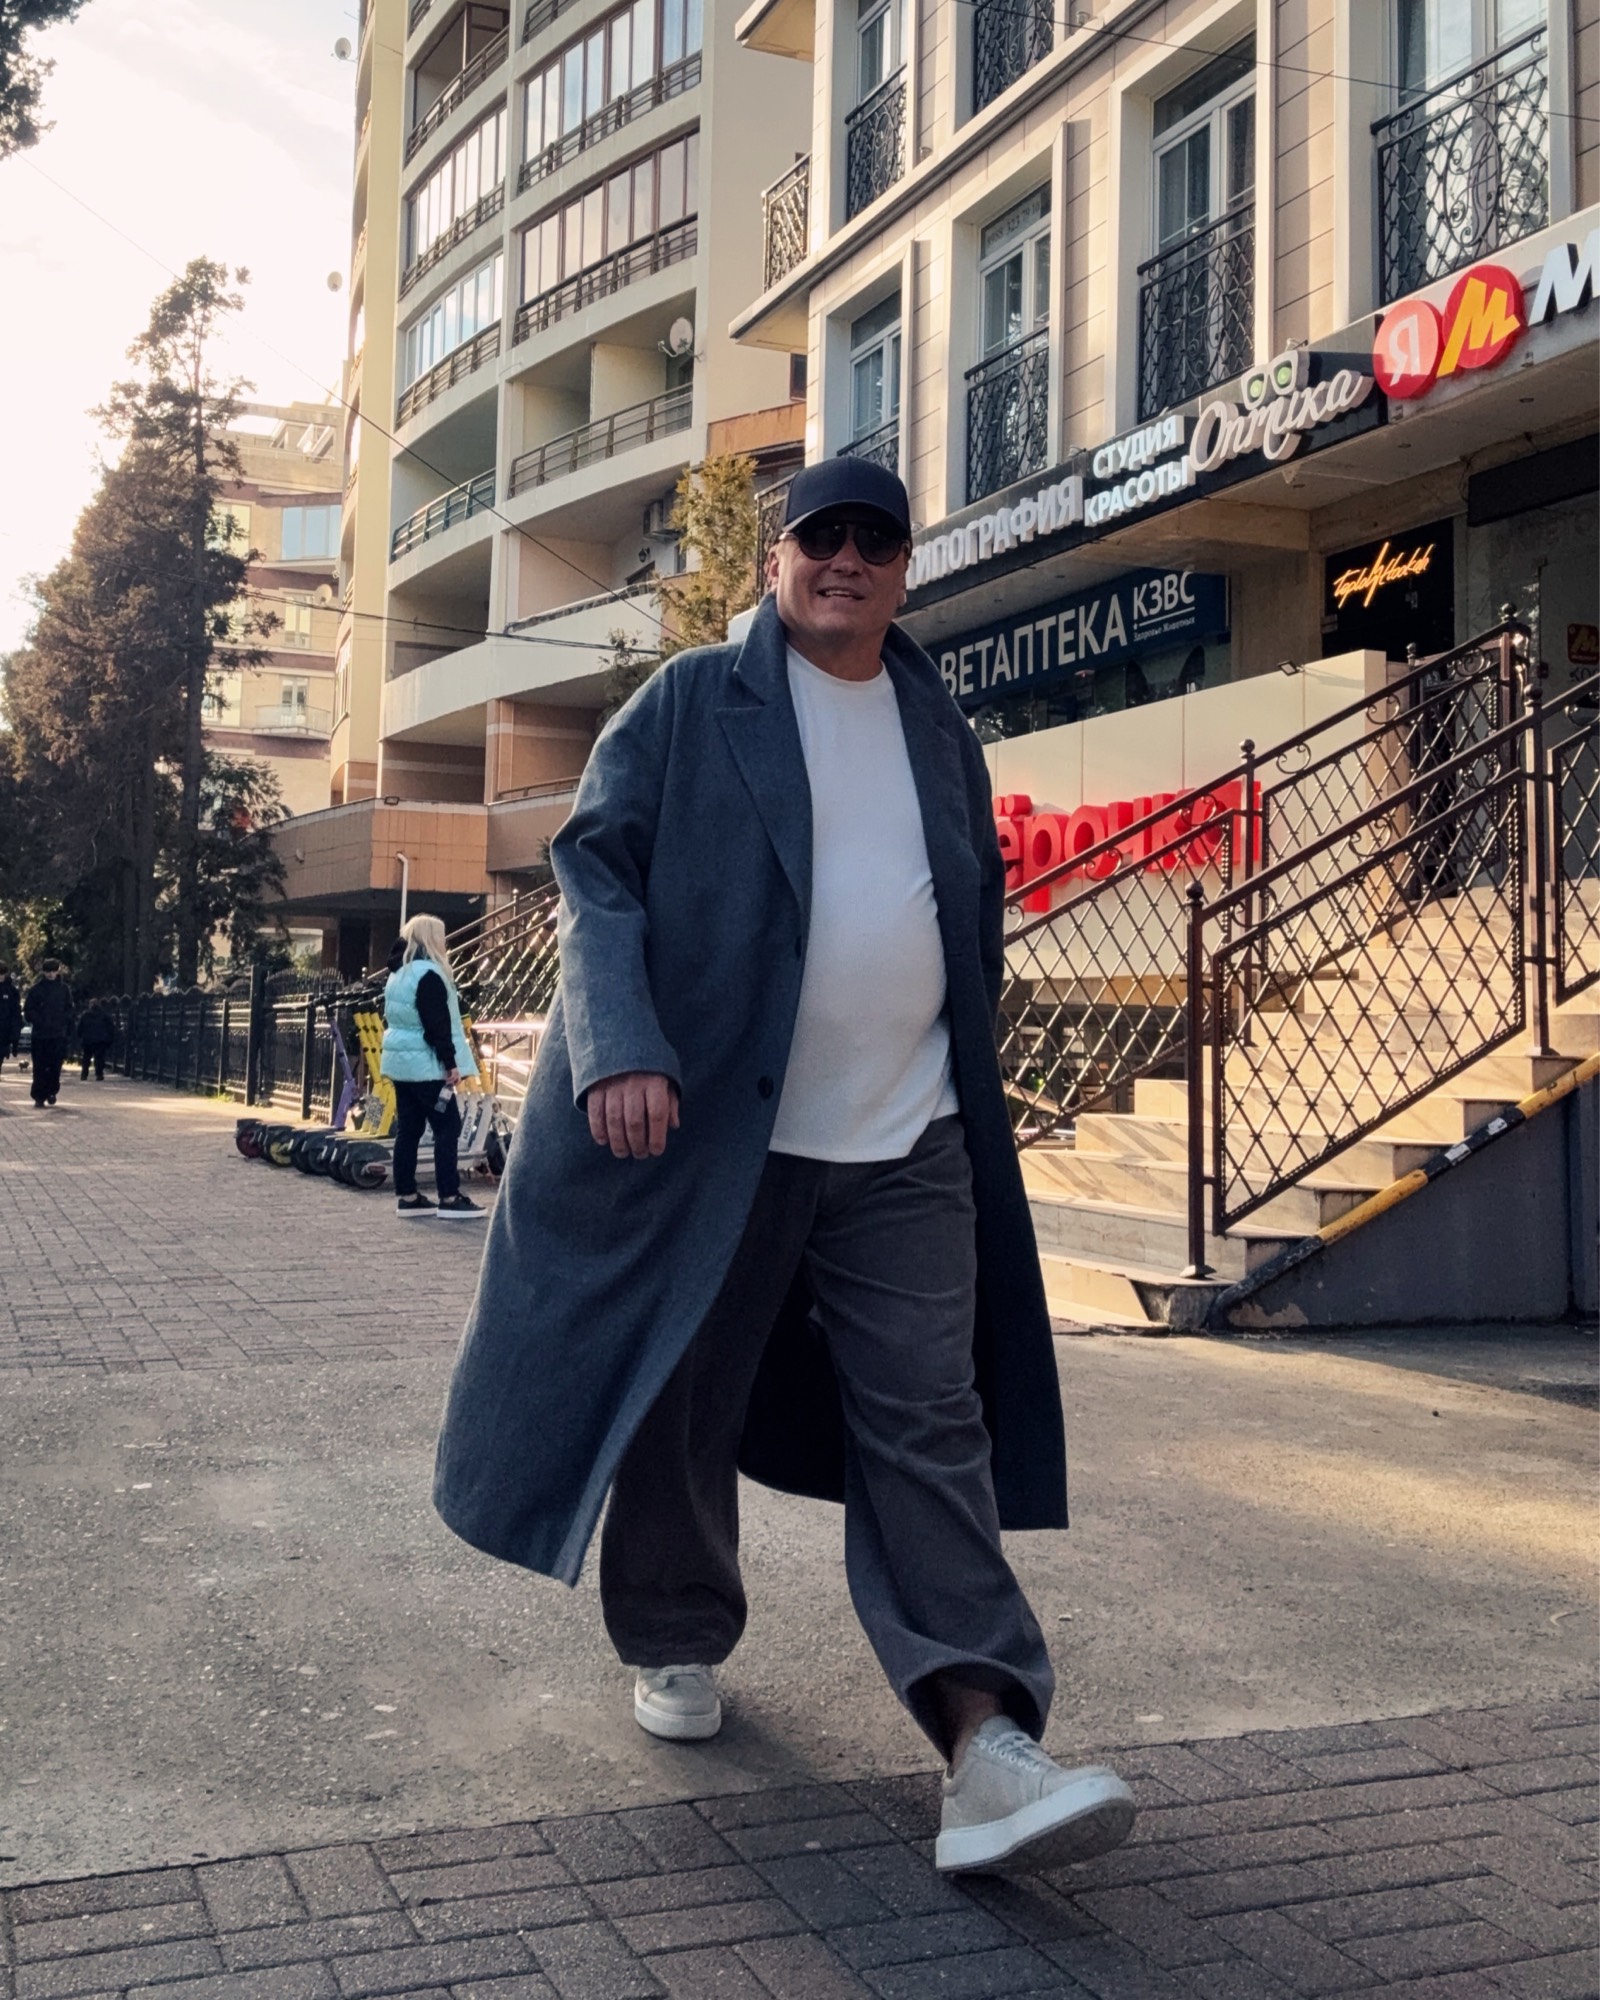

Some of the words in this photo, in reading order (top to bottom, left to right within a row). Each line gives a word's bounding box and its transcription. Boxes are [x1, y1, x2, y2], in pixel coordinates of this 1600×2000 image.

[1092, 415, 1184, 479] СТУДИЯ
[1190, 369, 1373, 471] Оптика
[1084, 455, 1195, 527] КРАСОТЫ
[941, 593, 1128, 698] ВЕТАПТЕКА
